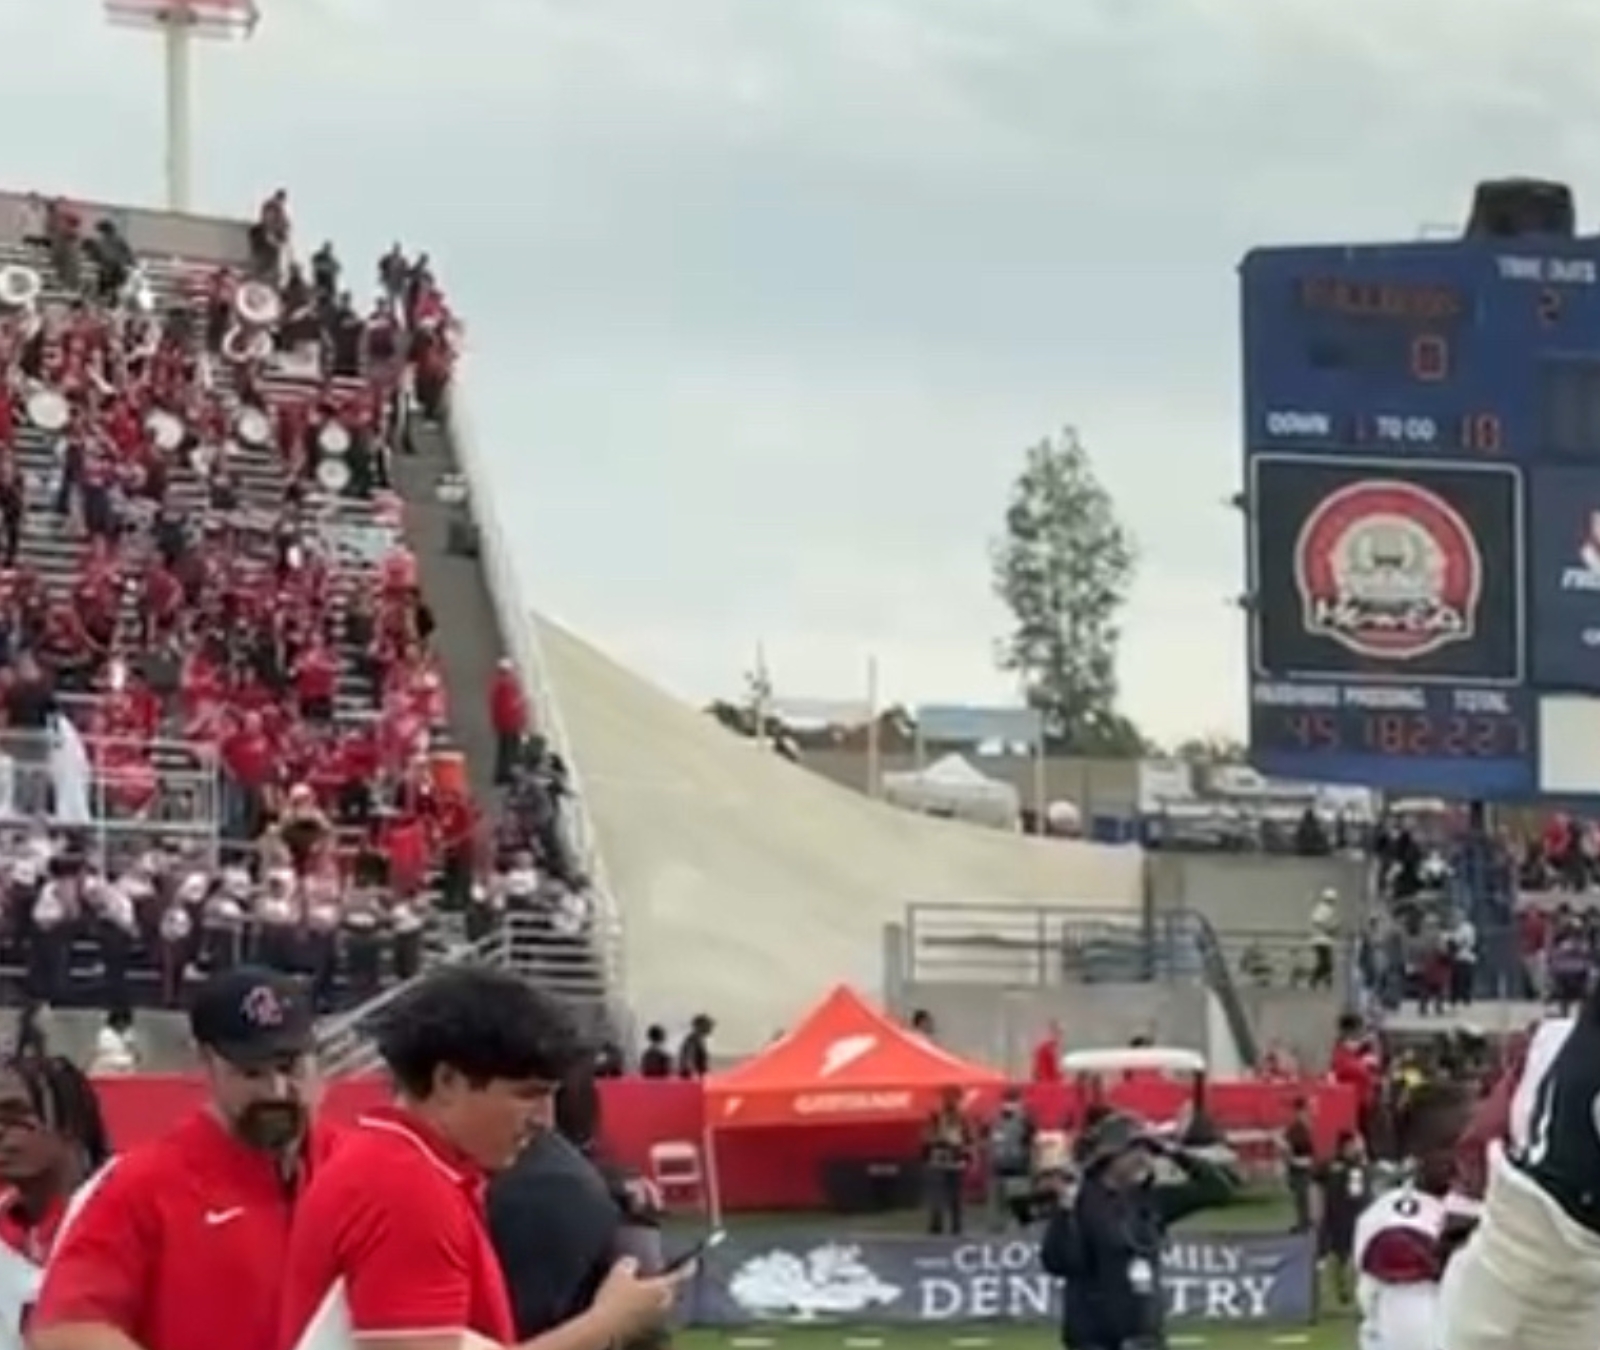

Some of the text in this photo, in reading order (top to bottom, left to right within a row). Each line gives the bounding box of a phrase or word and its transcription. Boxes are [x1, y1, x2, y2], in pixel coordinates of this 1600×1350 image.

[1547, 258, 1596, 283] OUTS
[1411, 334, 1448, 381] 0
[1266, 411, 1332, 437] DOWN
[1376, 413, 1402, 438] TO
[919, 1275, 1276, 1319] DENTRY
